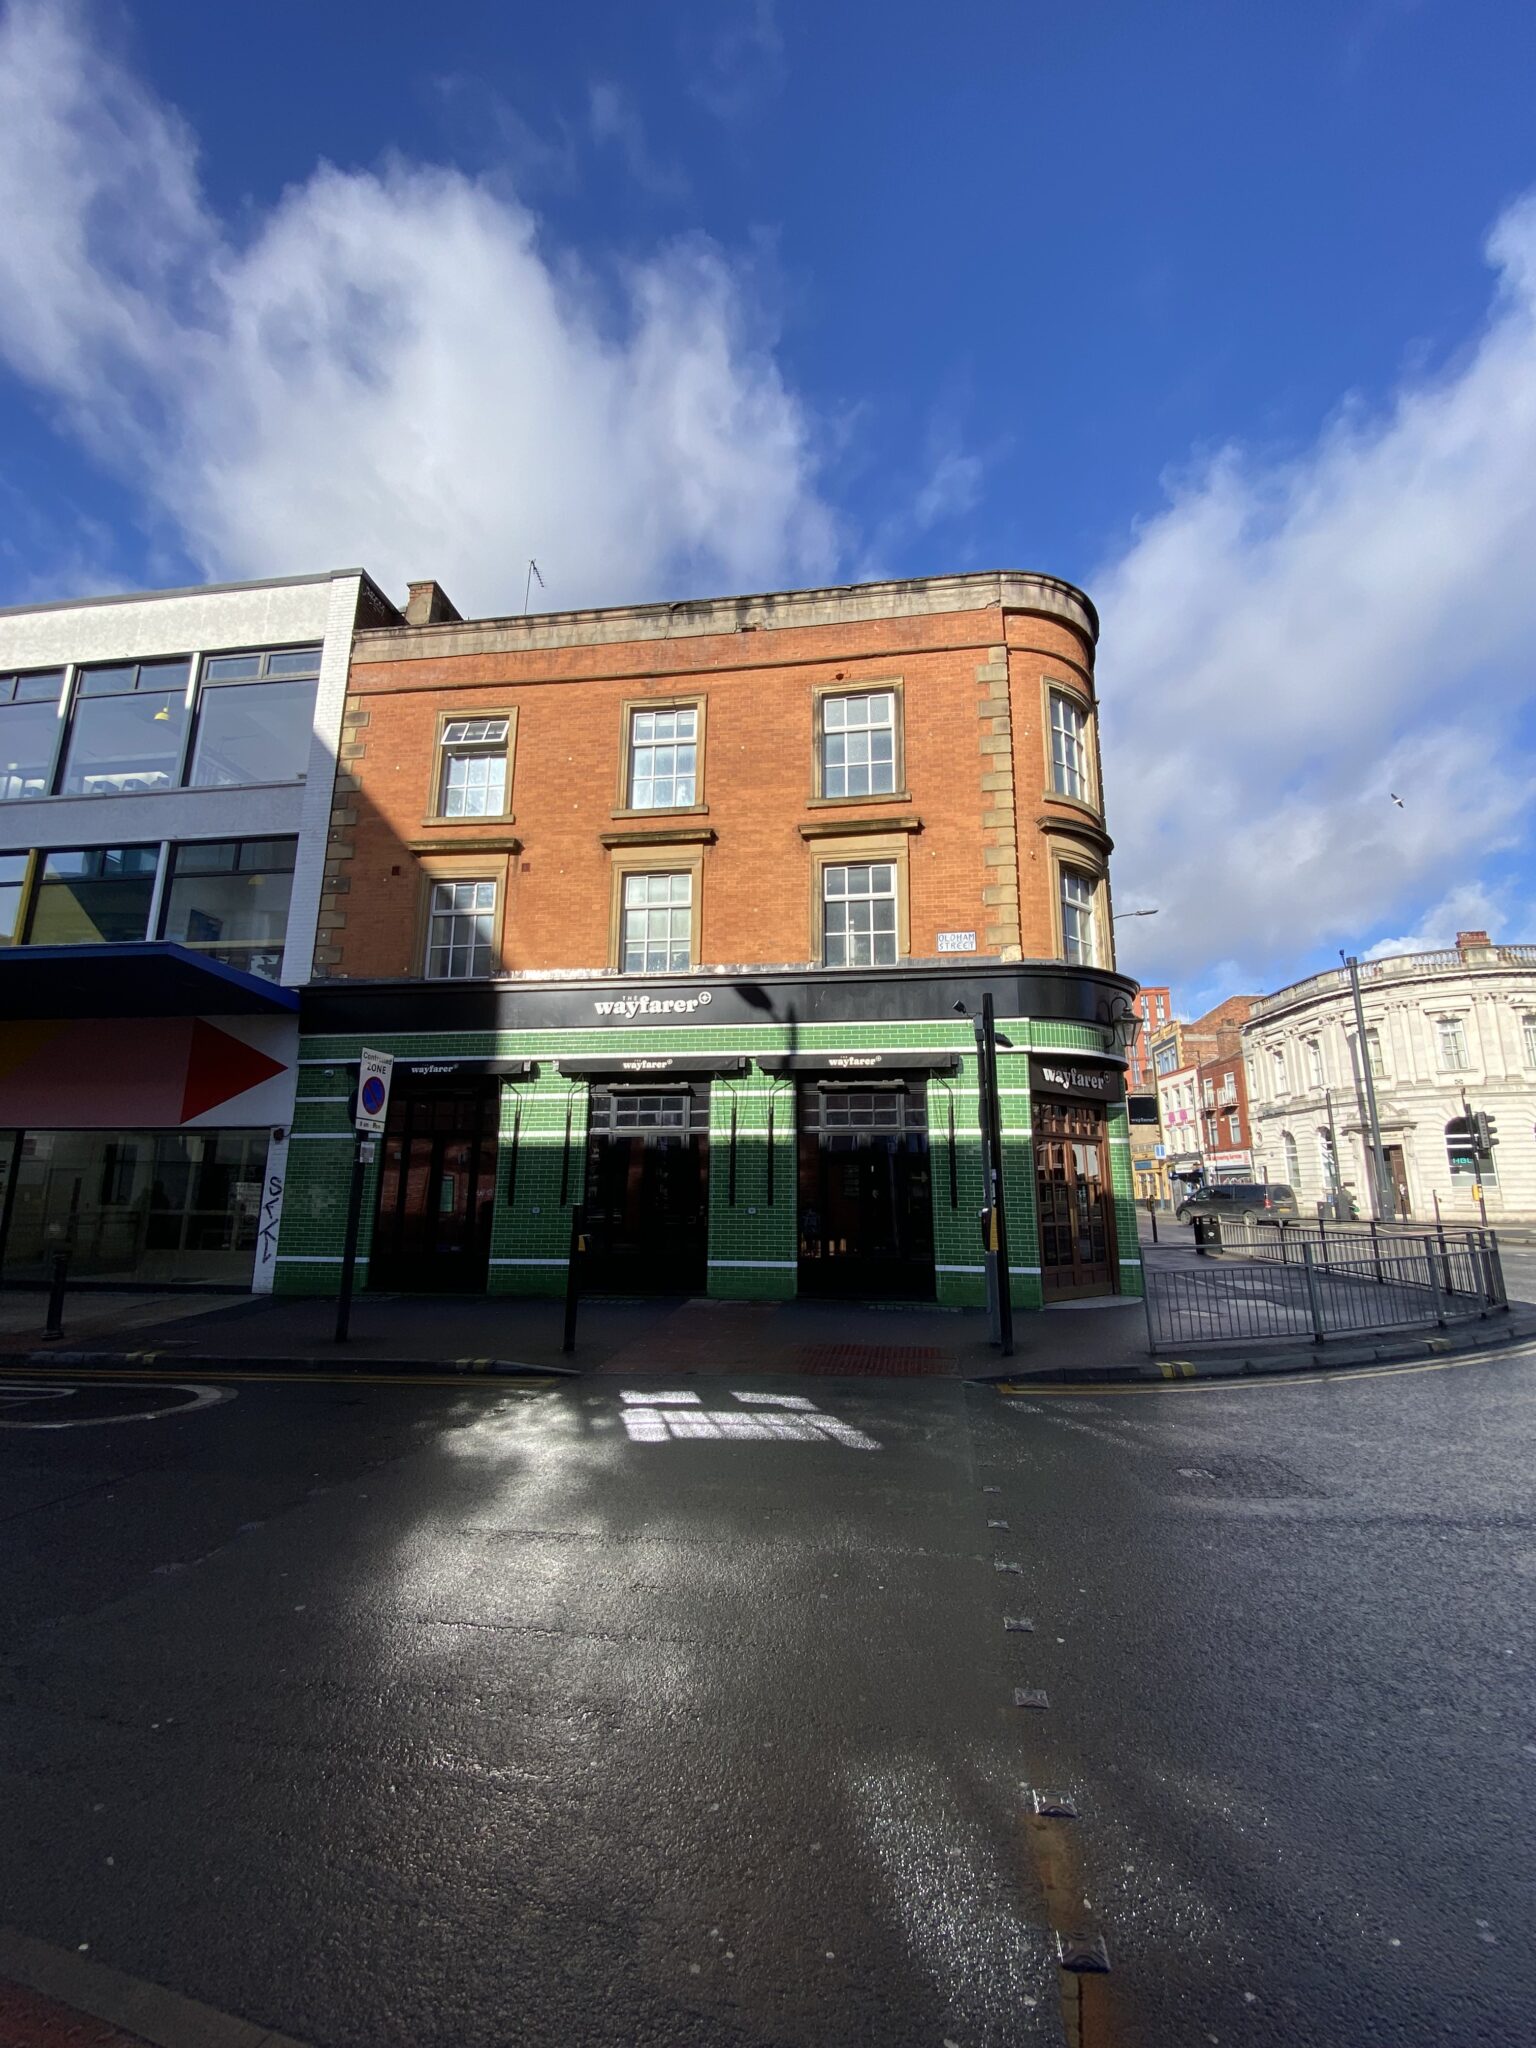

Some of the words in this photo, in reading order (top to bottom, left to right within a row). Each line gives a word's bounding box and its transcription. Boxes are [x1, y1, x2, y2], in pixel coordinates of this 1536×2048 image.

[938, 933, 975, 942] OLDHAM
[939, 941, 975, 950] STREET
[594, 995, 699, 1019] wayfarer
[622, 1060, 668, 1071] wayfarer
[828, 1056, 876, 1068] wayfarer
[367, 1062, 387, 1075] ZONE
[411, 1064, 454, 1075] wayfarer
[1042, 1066, 1105, 1089] wayfarer
